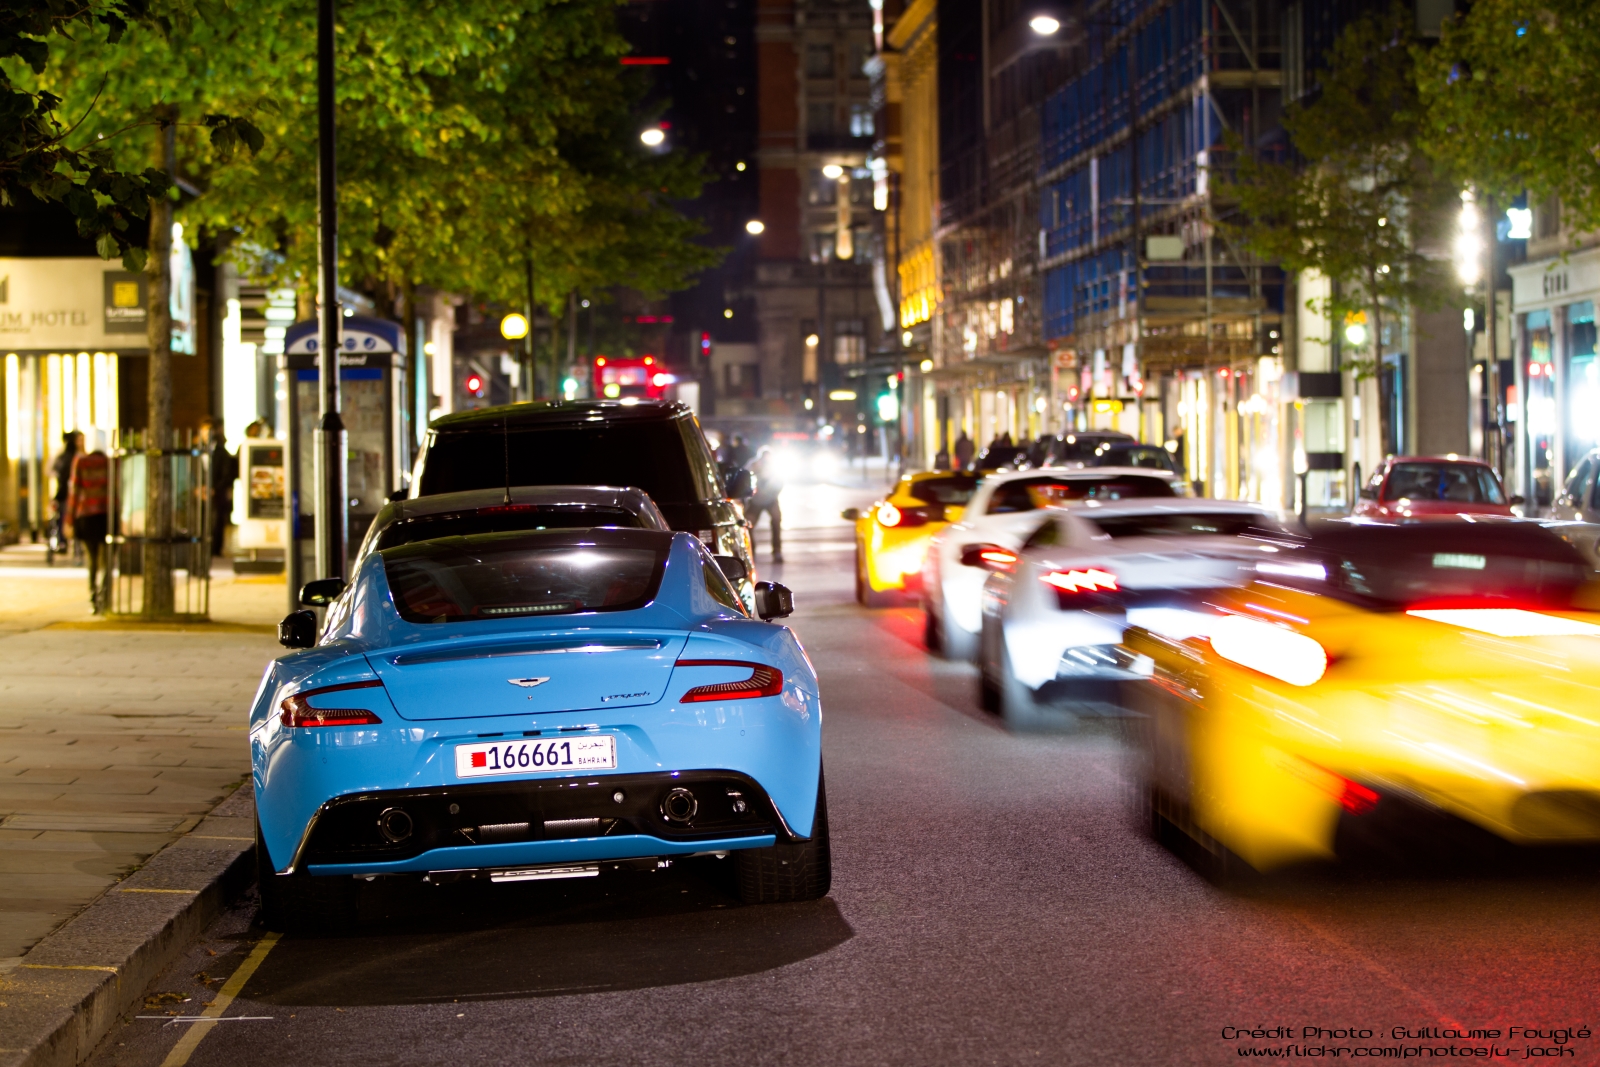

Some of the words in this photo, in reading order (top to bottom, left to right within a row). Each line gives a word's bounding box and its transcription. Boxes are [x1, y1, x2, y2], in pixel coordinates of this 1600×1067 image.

[31, 310, 88, 327] HOTEL
[488, 741, 574, 770] 166661
[578, 756, 607, 765] BAHRAIN
